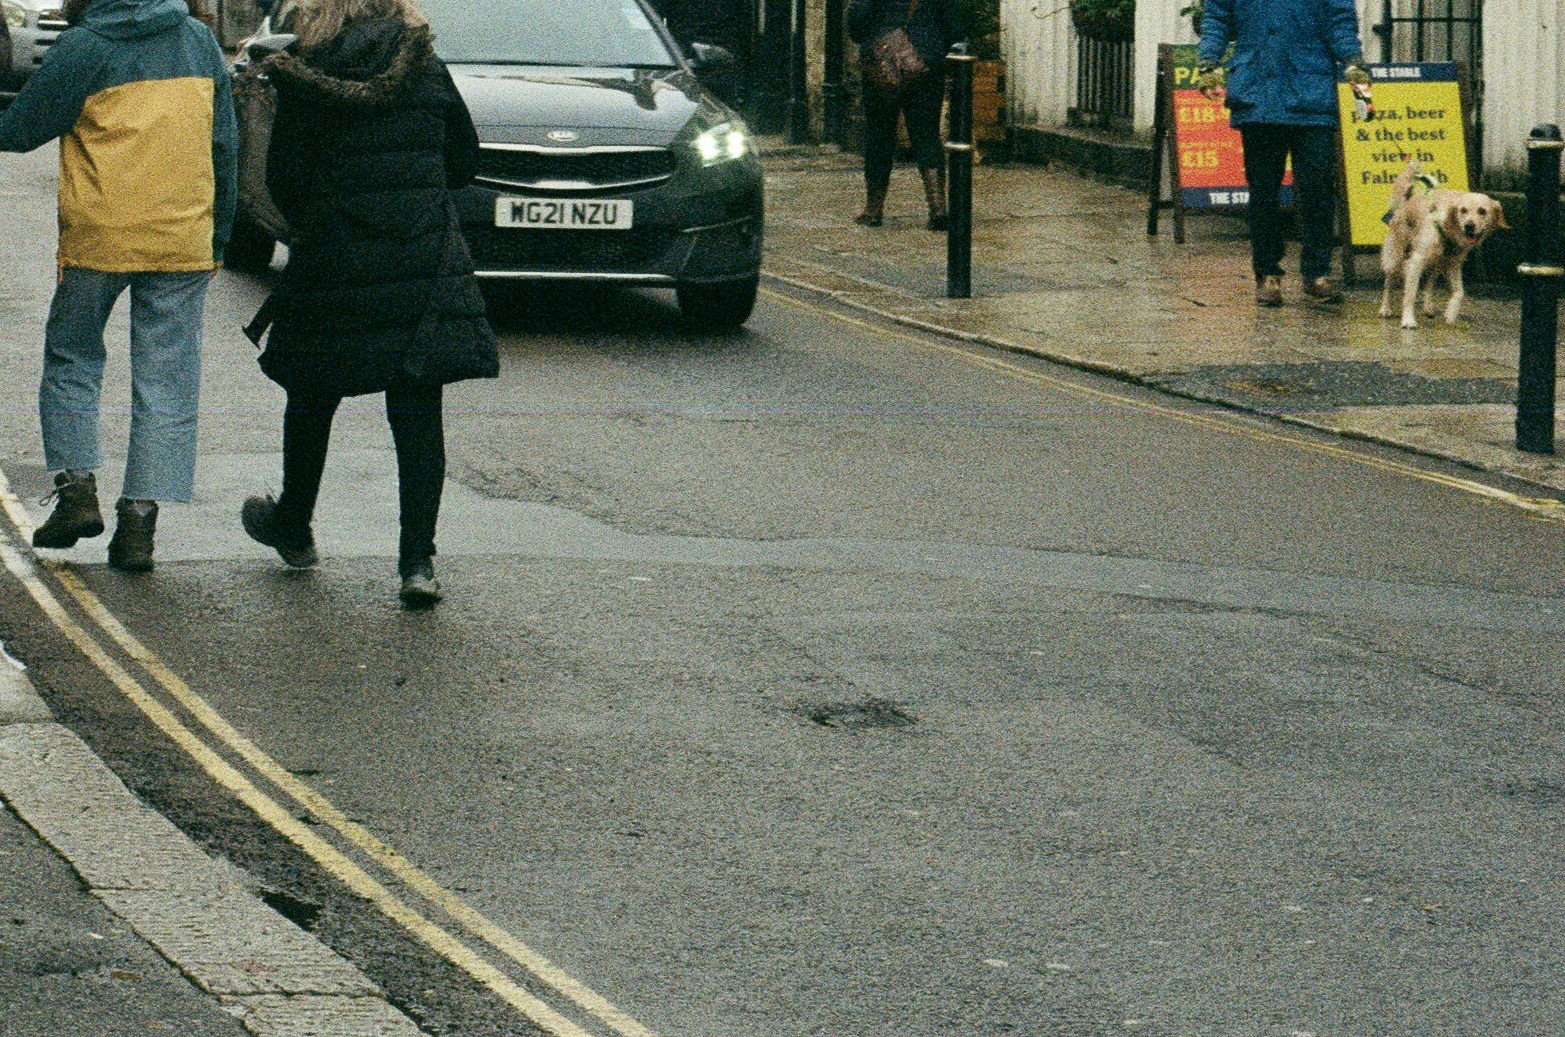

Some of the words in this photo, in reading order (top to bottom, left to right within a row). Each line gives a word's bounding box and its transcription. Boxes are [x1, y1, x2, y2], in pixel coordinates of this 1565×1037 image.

[1406, 106, 1446, 120] beer
[1356, 128, 1371, 142] &
[1375, 127, 1404, 141] the
[1407, 126, 1446, 141] best
[1181, 151, 1220, 168] £15
[1416, 148, 1434, 162] in
[1209, 191, 1231, 205] THE
[571, 202, 618, 225] NZU
